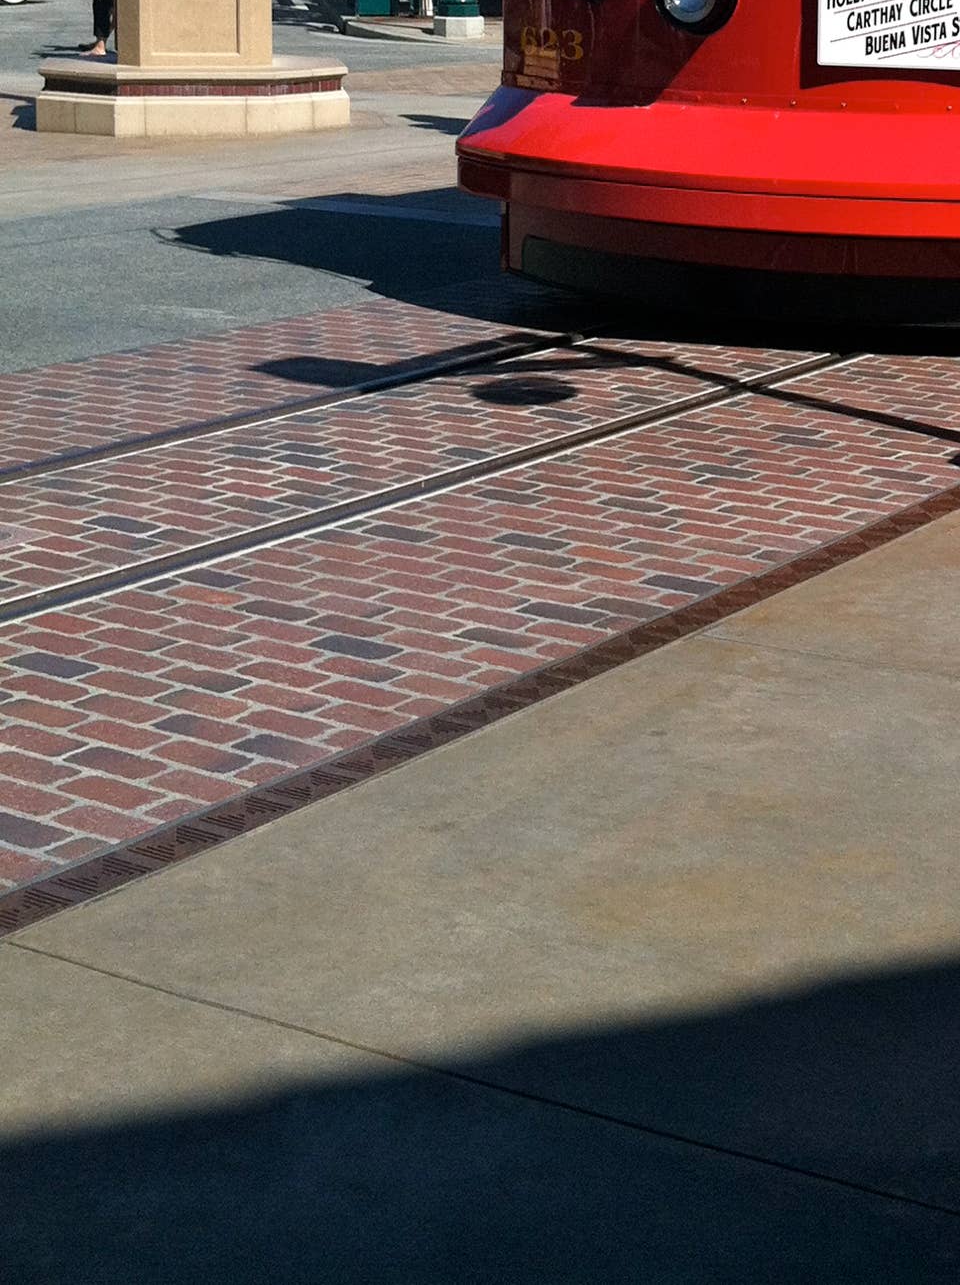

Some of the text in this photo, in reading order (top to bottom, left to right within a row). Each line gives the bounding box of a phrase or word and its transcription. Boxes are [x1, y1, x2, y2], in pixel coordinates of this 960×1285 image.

[846, 2, 904, 32] CARTHAY
[520, 26, 585, 61] 623
[864, 30, 907, 56] BUENA
[911, 18, 948, 46] VISTA
